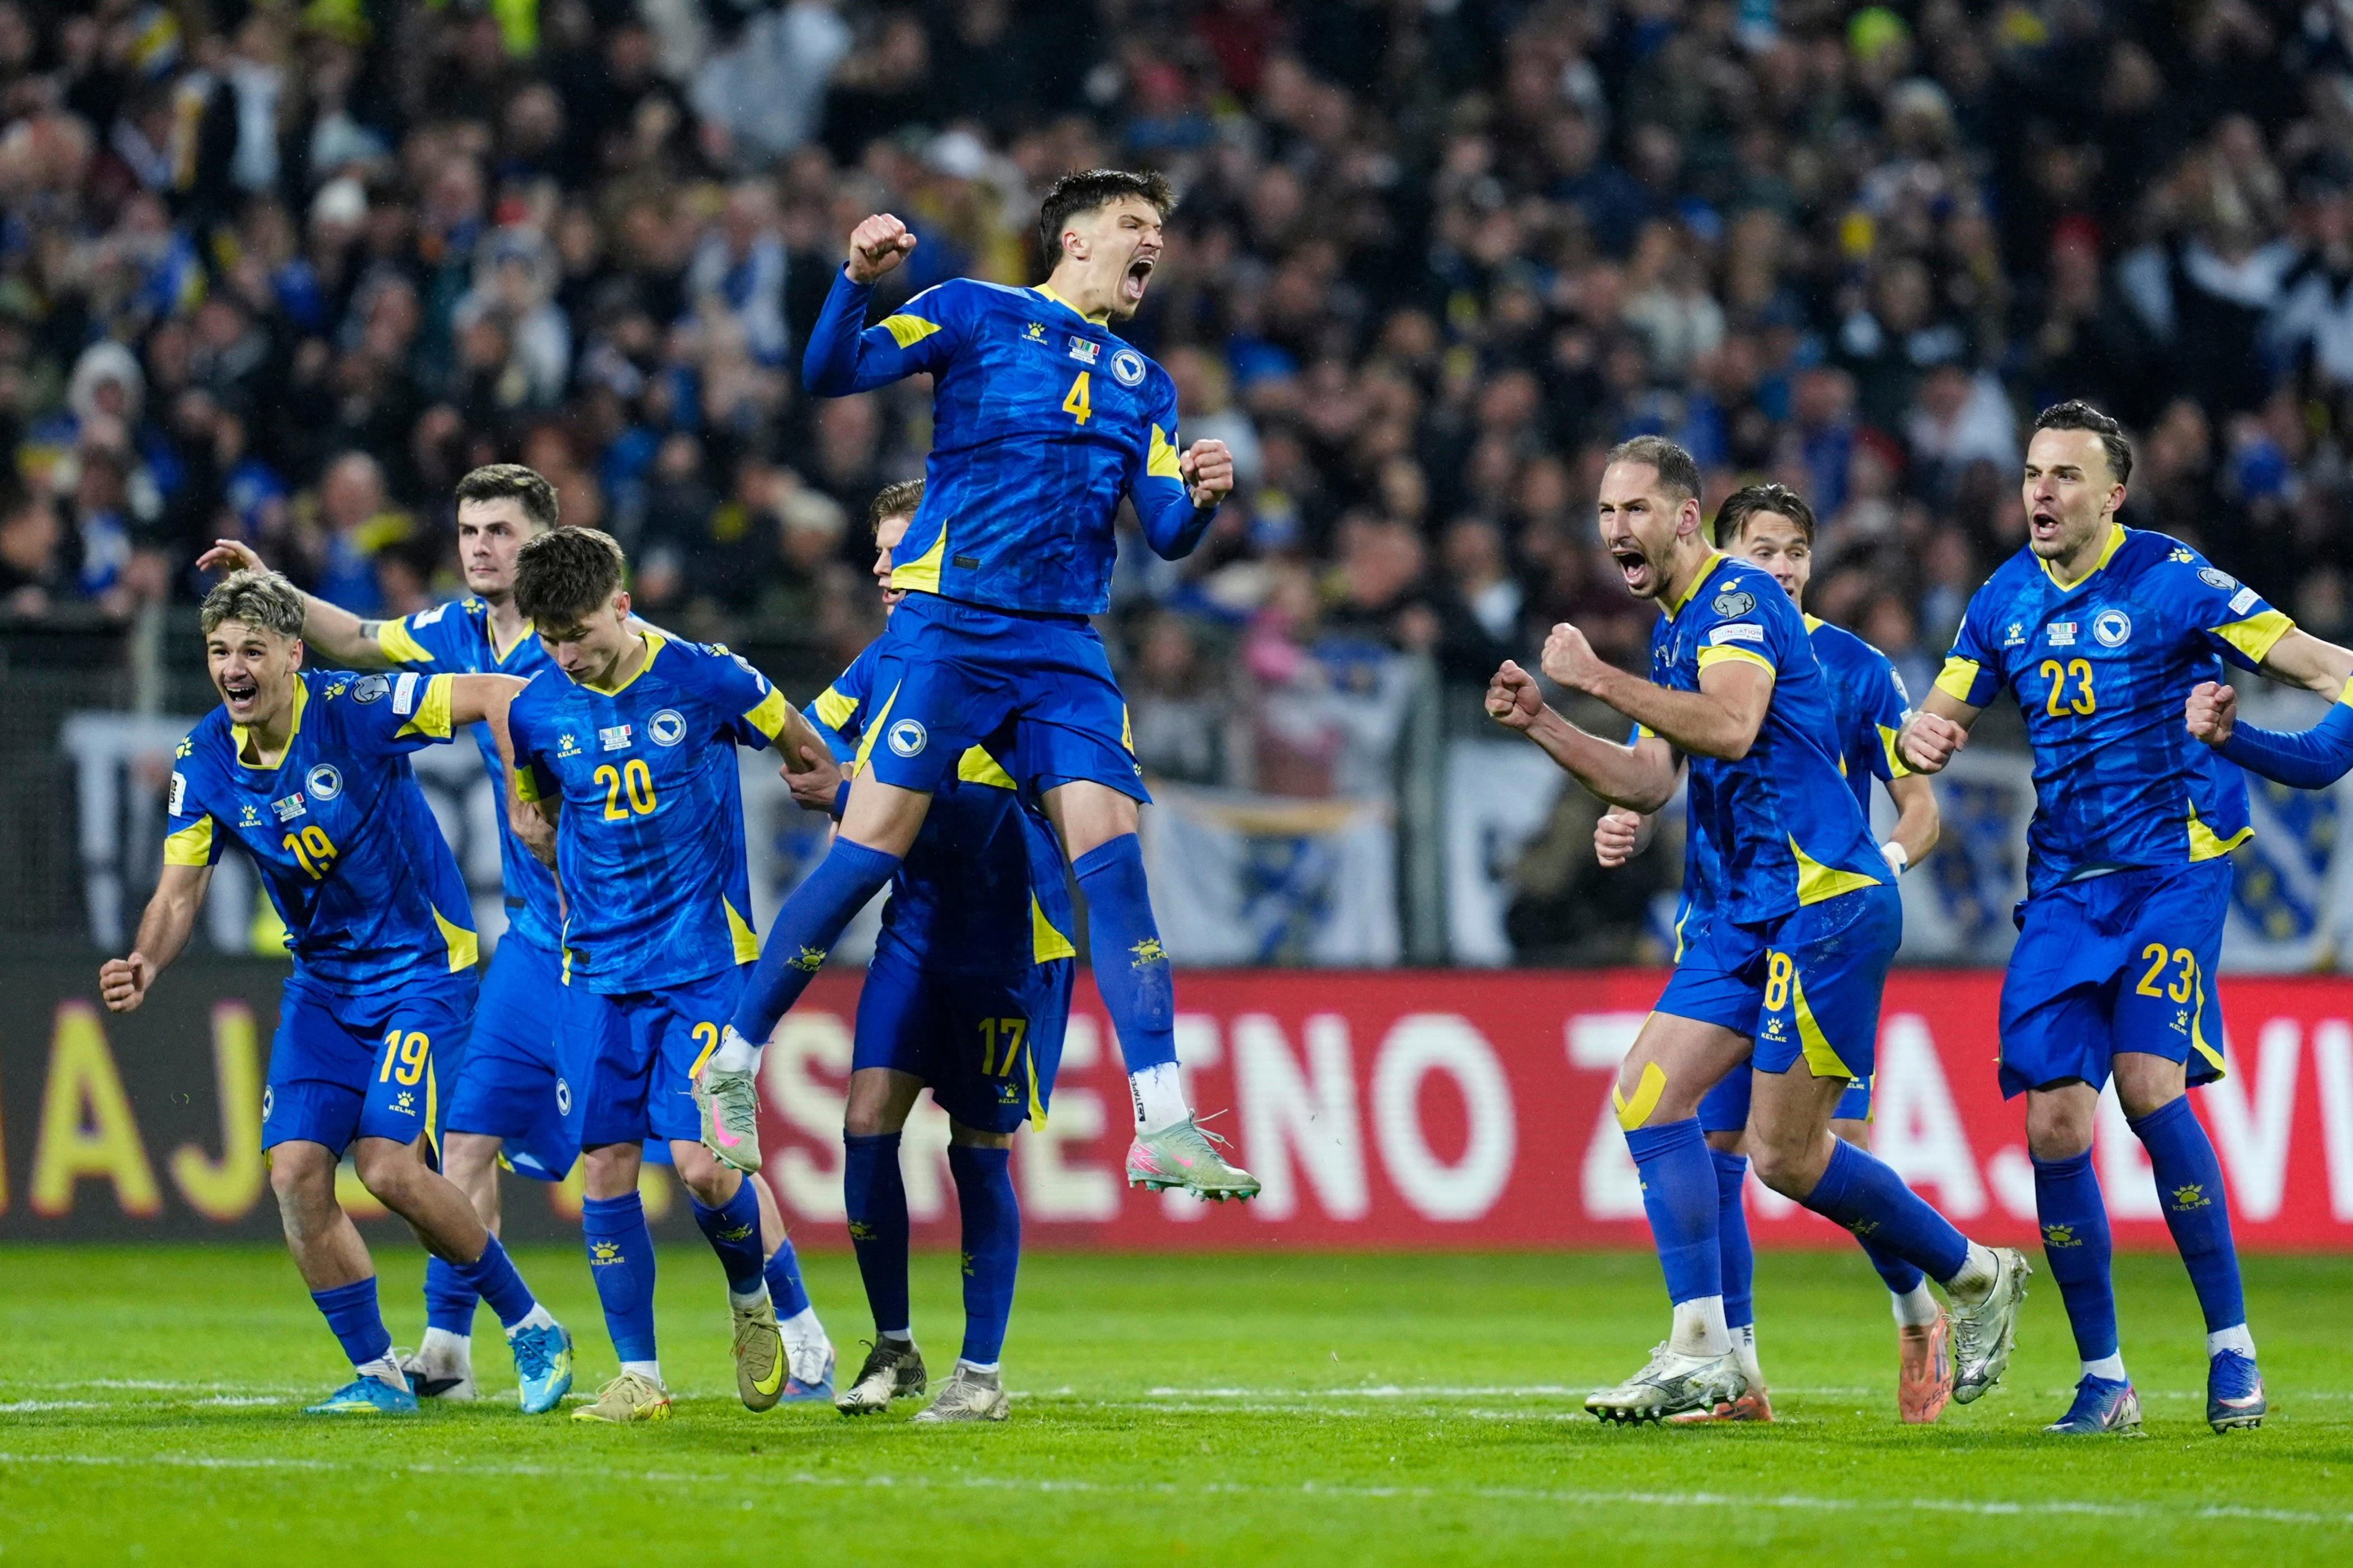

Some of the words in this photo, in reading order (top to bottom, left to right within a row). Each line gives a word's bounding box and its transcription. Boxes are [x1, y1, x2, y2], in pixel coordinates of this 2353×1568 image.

[1021, 334, 1048, 346] KELME
[1062, 370, 1092, 426] 4
[2003, 637, 2026, 646] KELME
[2040, 658, 2096, 717] 23
[557, 748, 582, 758] KELME
[593, 759, 657, 821] 20
[282, 825, 338, 880] 19
[1765, 948, 1793, 1012] 8
[2135, 943, 2195, 1004] 23
[689, 1021, 732, 1079] 2
[979, 1017, 1026, 1076] 17
[1761, 1032, 1787, 1043] KELME
[2169, 1022, 2188, 1036] KELME
[379, 1029, 430, 1085] 19
[388, 1104, 416, 1117] KELME
[2172, 1198, 2211, 1212] KELME
[591, 1256, 625, 1265] KELME
